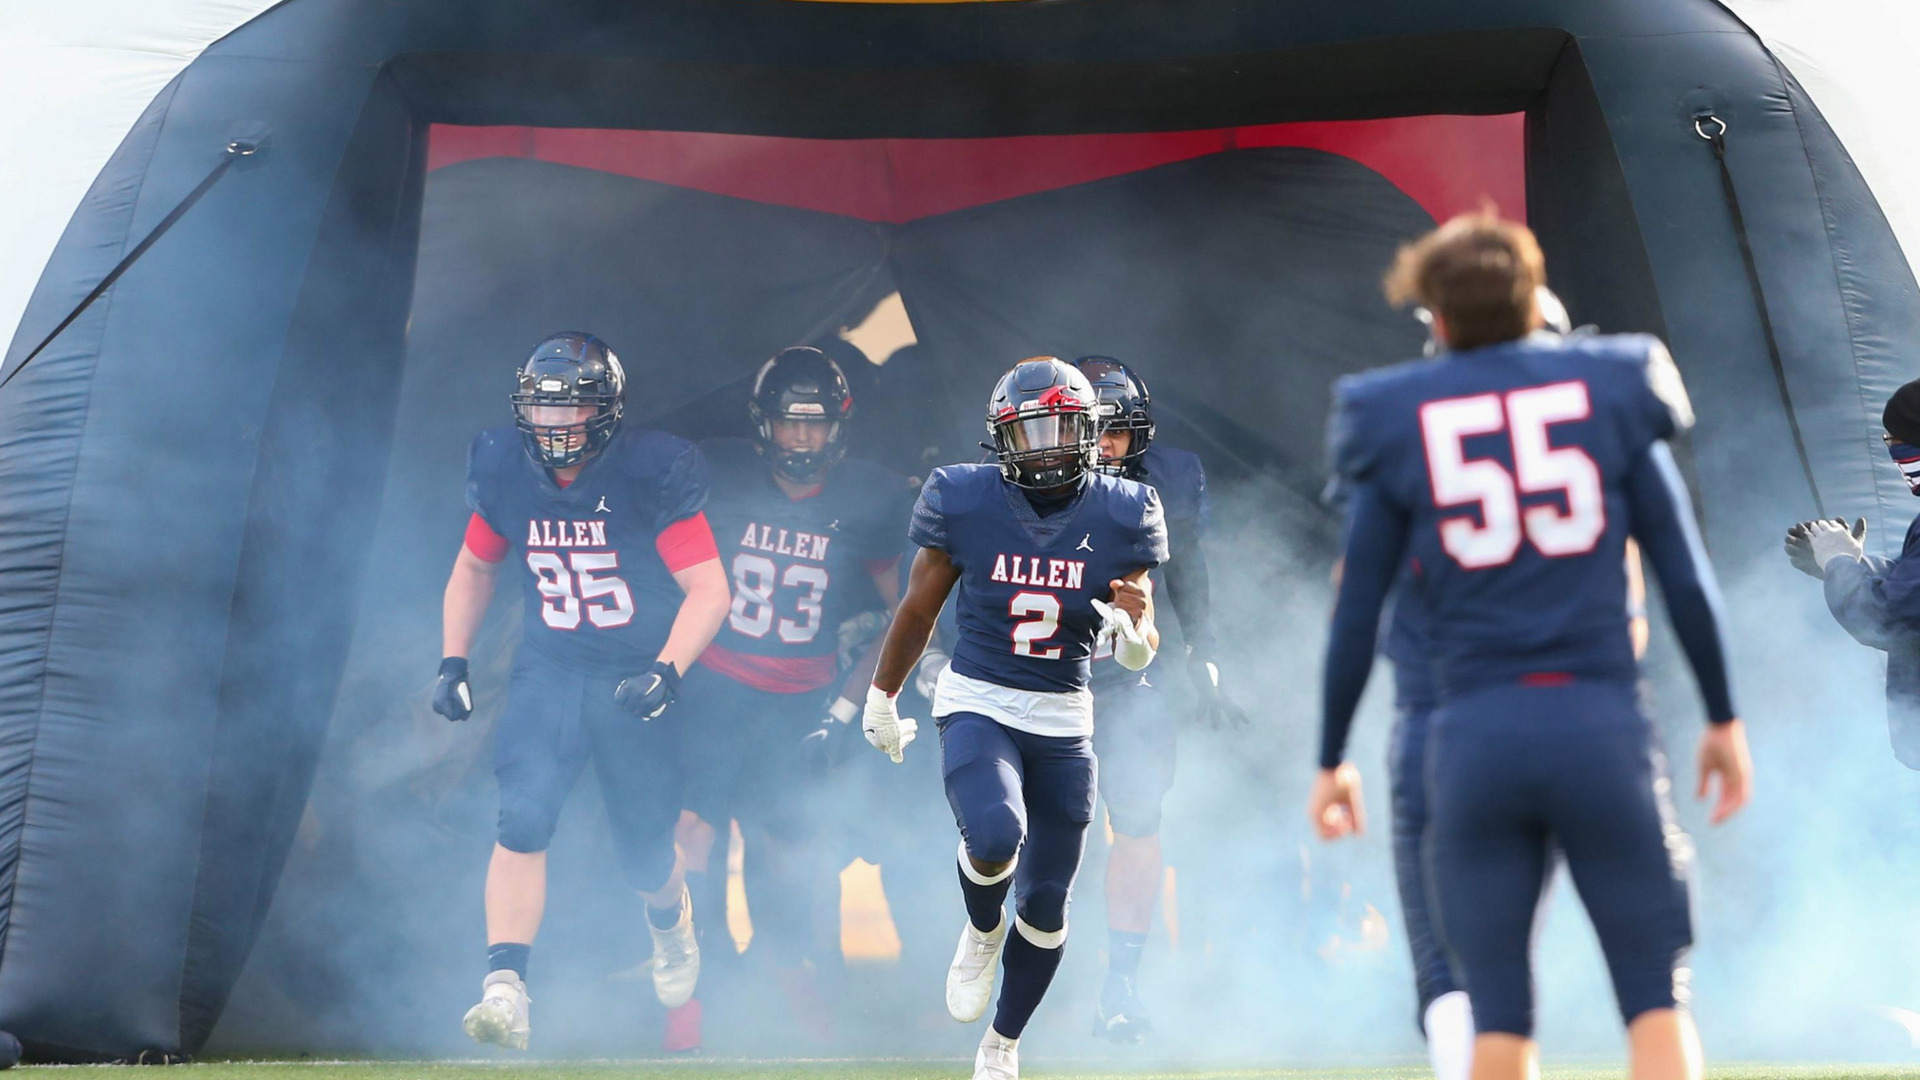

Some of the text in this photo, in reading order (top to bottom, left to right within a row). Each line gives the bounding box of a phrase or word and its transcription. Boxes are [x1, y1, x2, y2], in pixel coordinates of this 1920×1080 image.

[1418, 378, 1608, 571] 55
[526, 519, 607, 547] ALLEN
[740, 521, 831, 561] ALLEN
[526, 550, 635, 631] 95
[728, 551, 829, 644] 83
[989, 552, 1086, 591] ALLEN
[1008, 590, 1063, 660] 2
